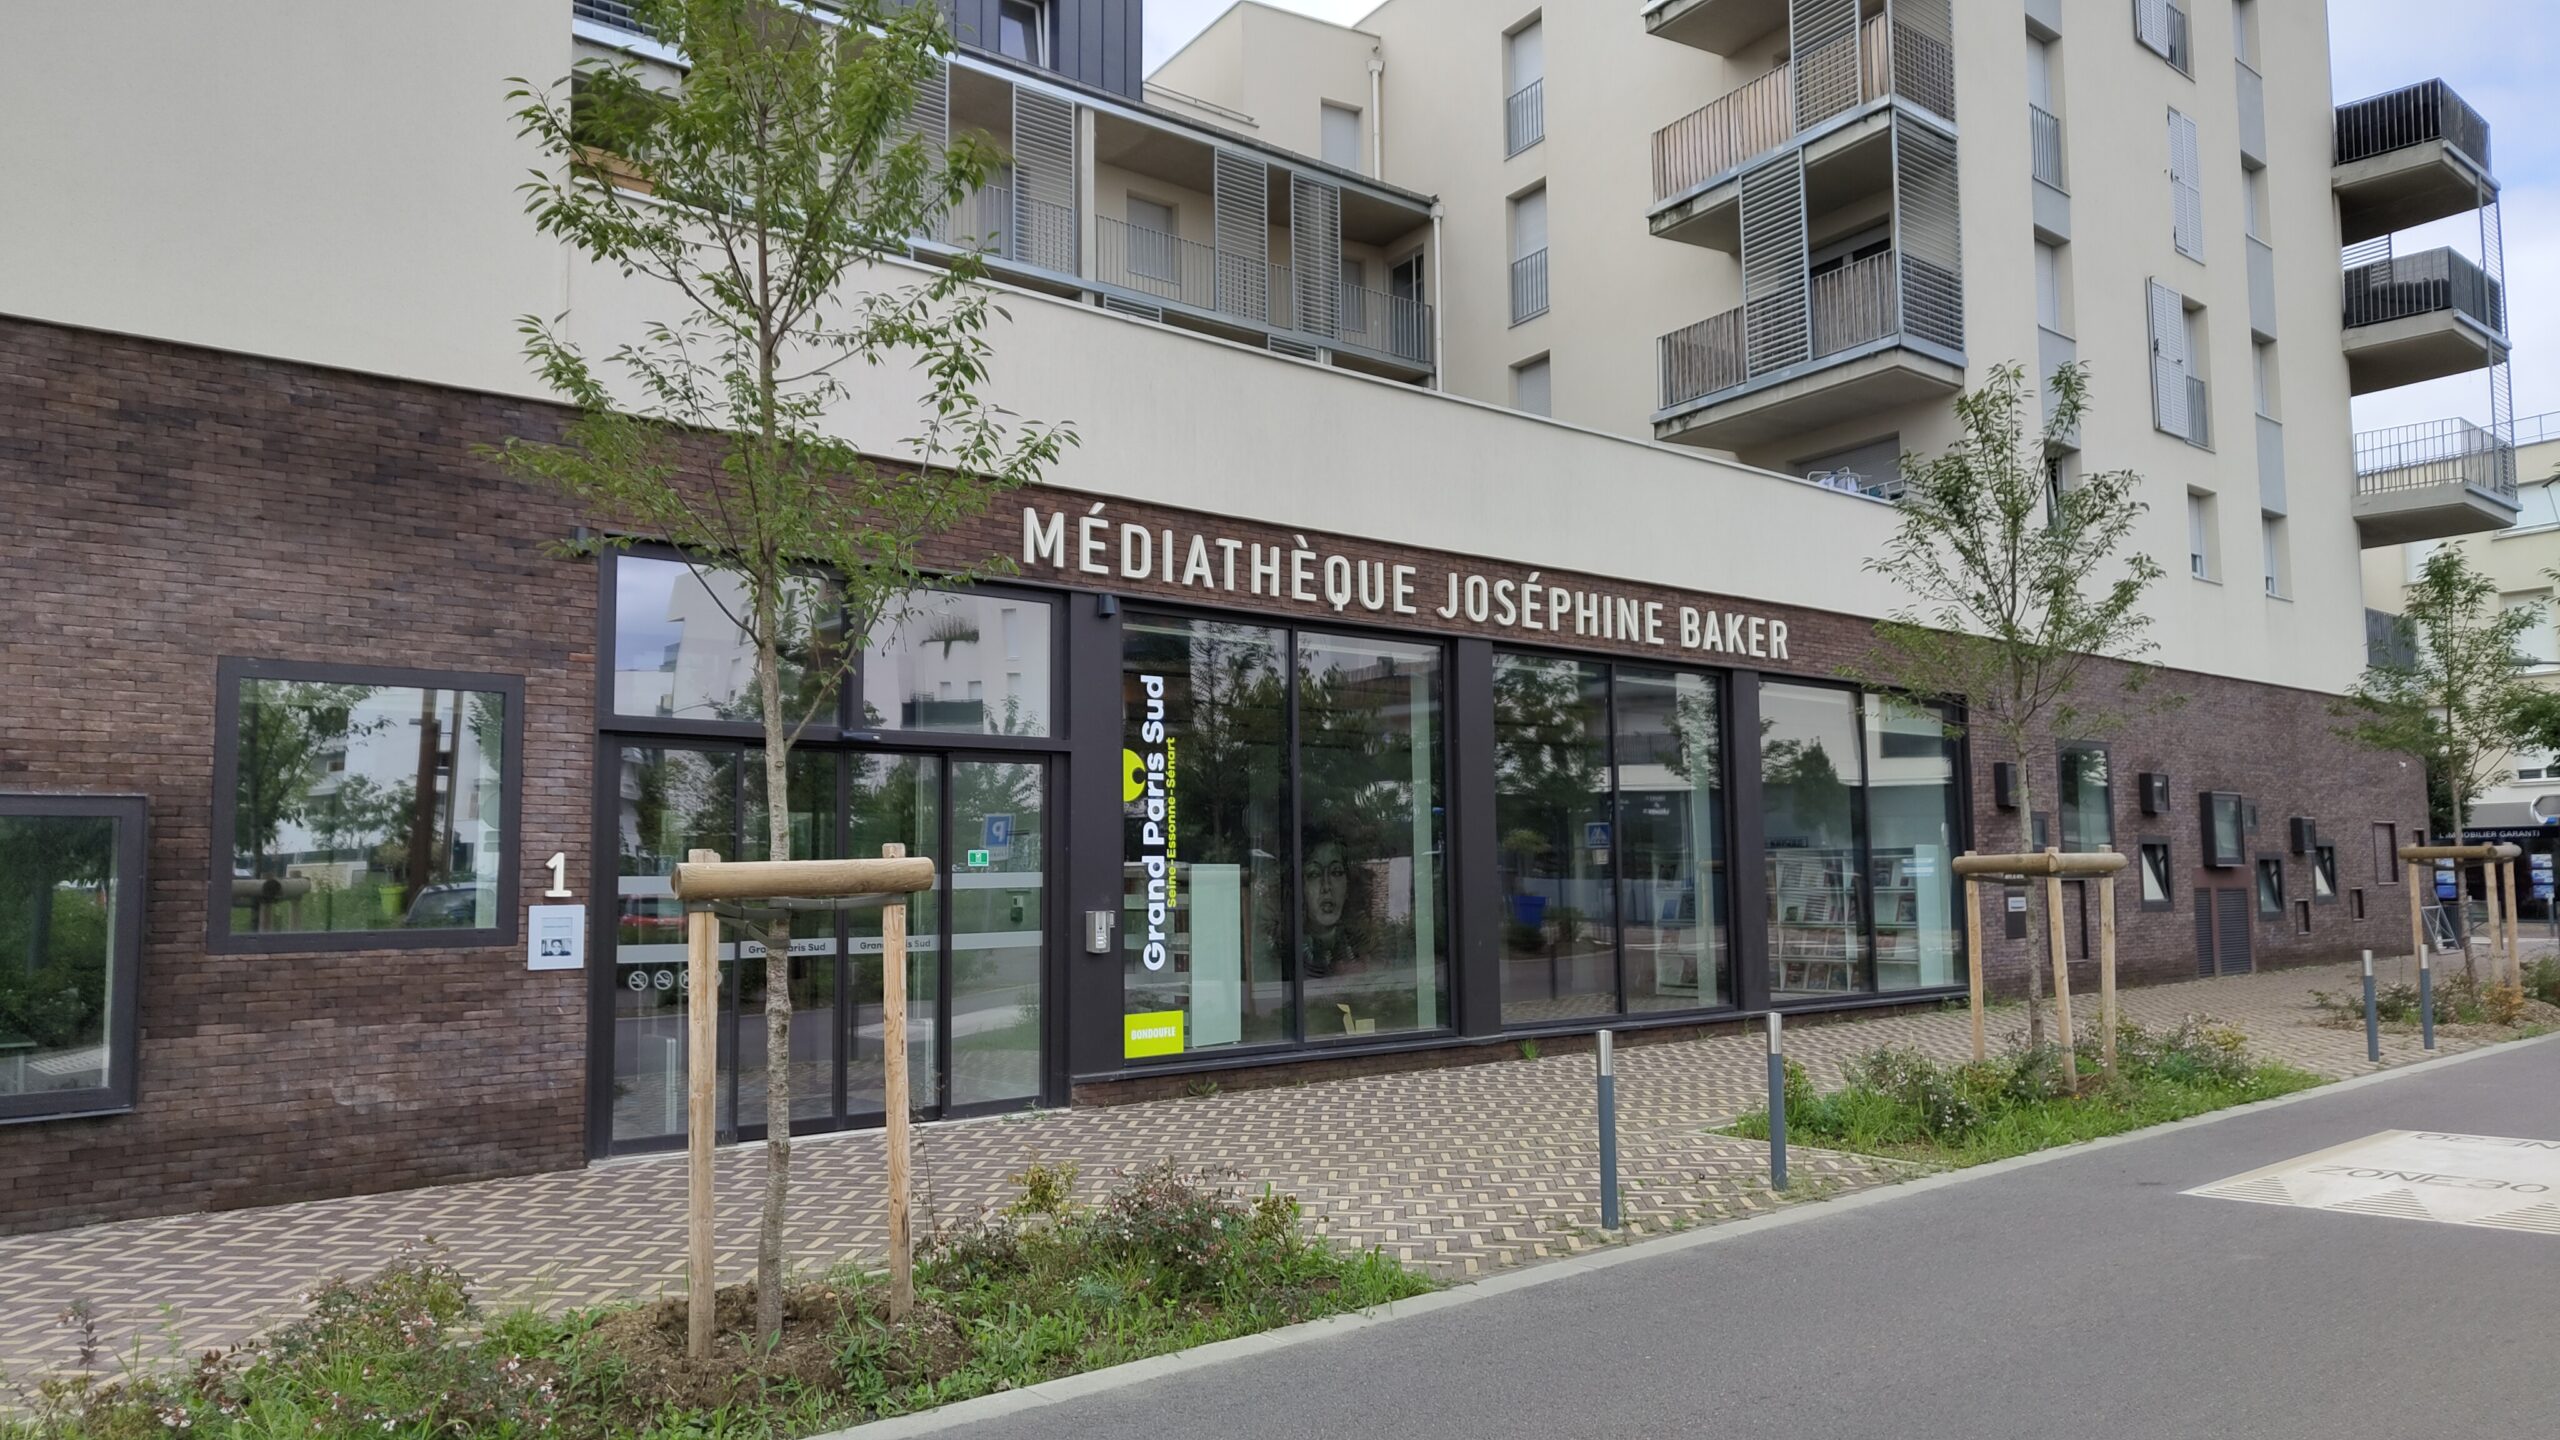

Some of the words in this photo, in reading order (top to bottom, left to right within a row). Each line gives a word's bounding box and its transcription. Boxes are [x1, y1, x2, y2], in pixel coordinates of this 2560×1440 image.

[1022, 502, 1418, 614] MÉDIATHÈQUE
[1436, 571, 1665, 646] JOSÉPHINE
[1679, 606, 1790, 660] BAKER
[1140, 674, 1165, 744] Sud
[1142, 752, 1166, 845] Paris
[1166, 736, 1177, 908] Seine-Essonne-Sénart
[2499, 829, 2541, 838] GARANTI
[544, 851, 573, 898] 1
[1141, 855, 1166, 971] Grand
[788, 943, 807, 952] aris
[807, 942, 826, 951] Sud
[860, 941, 884, 950] Gran
[914, 939, 931, 948] Sud
[1130, 1025, 1177, 1041] BONDOUFLE
[2309, 1165, 2471, 1189] ZONE
